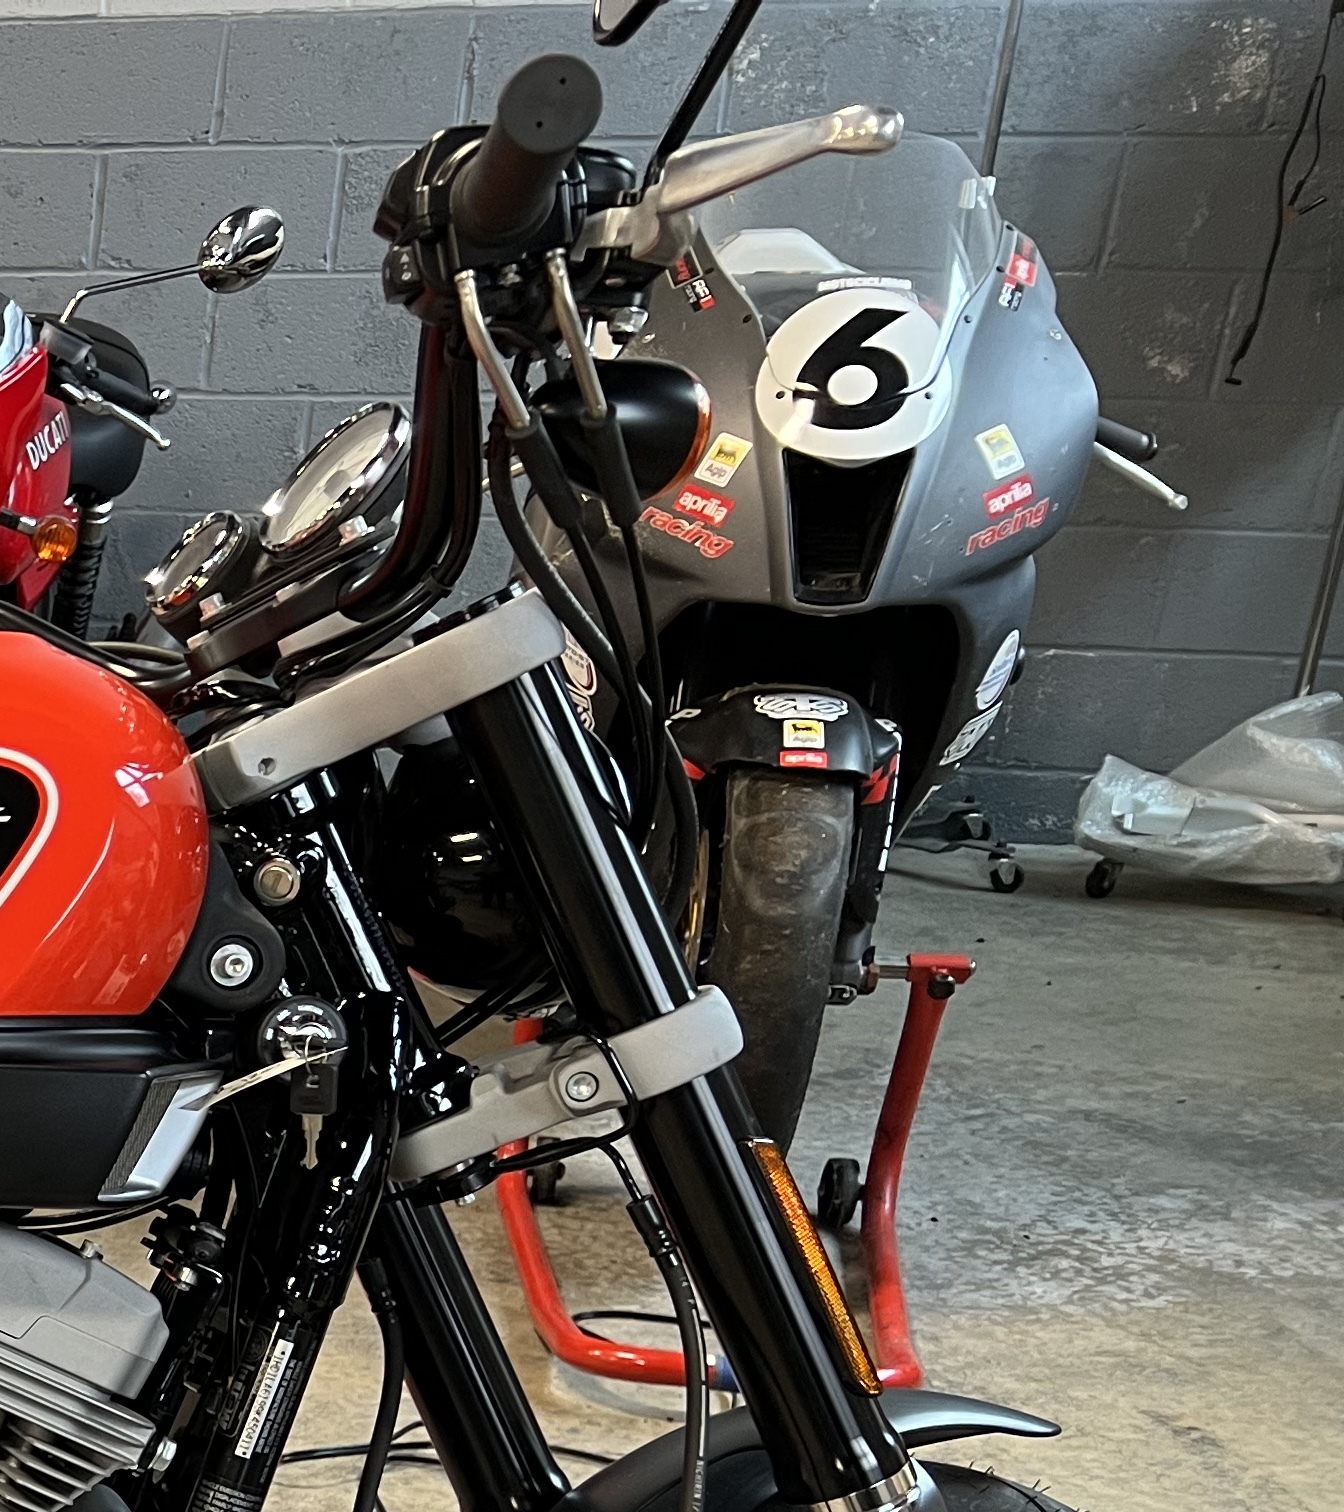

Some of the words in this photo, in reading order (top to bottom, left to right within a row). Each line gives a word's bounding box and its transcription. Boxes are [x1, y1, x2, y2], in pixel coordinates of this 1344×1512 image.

[793, 308, 910, 430] 6
[25, 410, 70, 471] DUCATI
[678, 491, 728, 524] aprilia
[987, 481, 1033, 514] aprilia
[638, 505, 735, 559] racing
[965, 496, 1051, 557] racing
